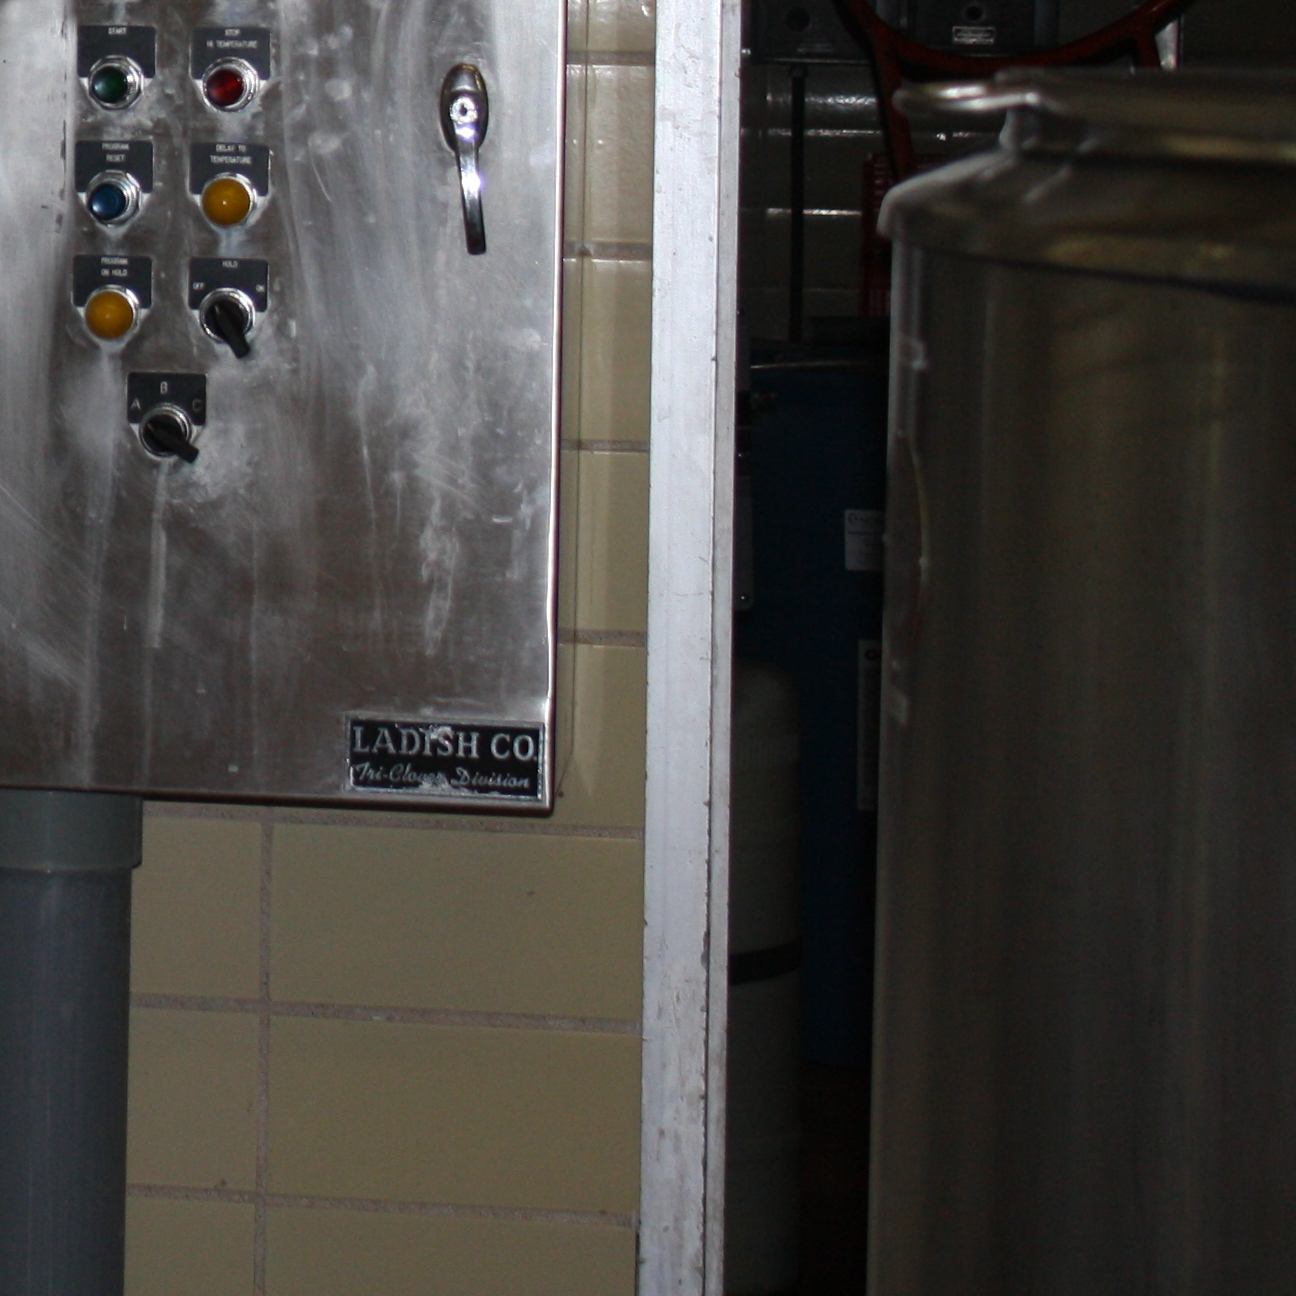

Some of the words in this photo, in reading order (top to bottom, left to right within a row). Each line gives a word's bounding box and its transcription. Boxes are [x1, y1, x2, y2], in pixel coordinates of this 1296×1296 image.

[108, 27, 127, 35] START
[216, 41, 258, 49] TEMPERATURE
[102, 142, 130, 151] PROGRAM
[105, 153, 125, 162] RESET
[210, 155, 252, 164] TEMPERATURE
[222, 260, 239, 269] HOLD
[112, 269, 128, 277] HOLD
[193, 282, 205, 291] OFF
[256, 283, 265, 292] ON
[160, 381, 168, 395] B
[130, 397, 142, 411] A
[192, 398, 202, 412] C
[352, 724, 481, 760] LADISH
[490, 732, 538, 763] CO.
[354, 761, 448, 785] Tri-Clover
[451, 767, 531, 789] Division
